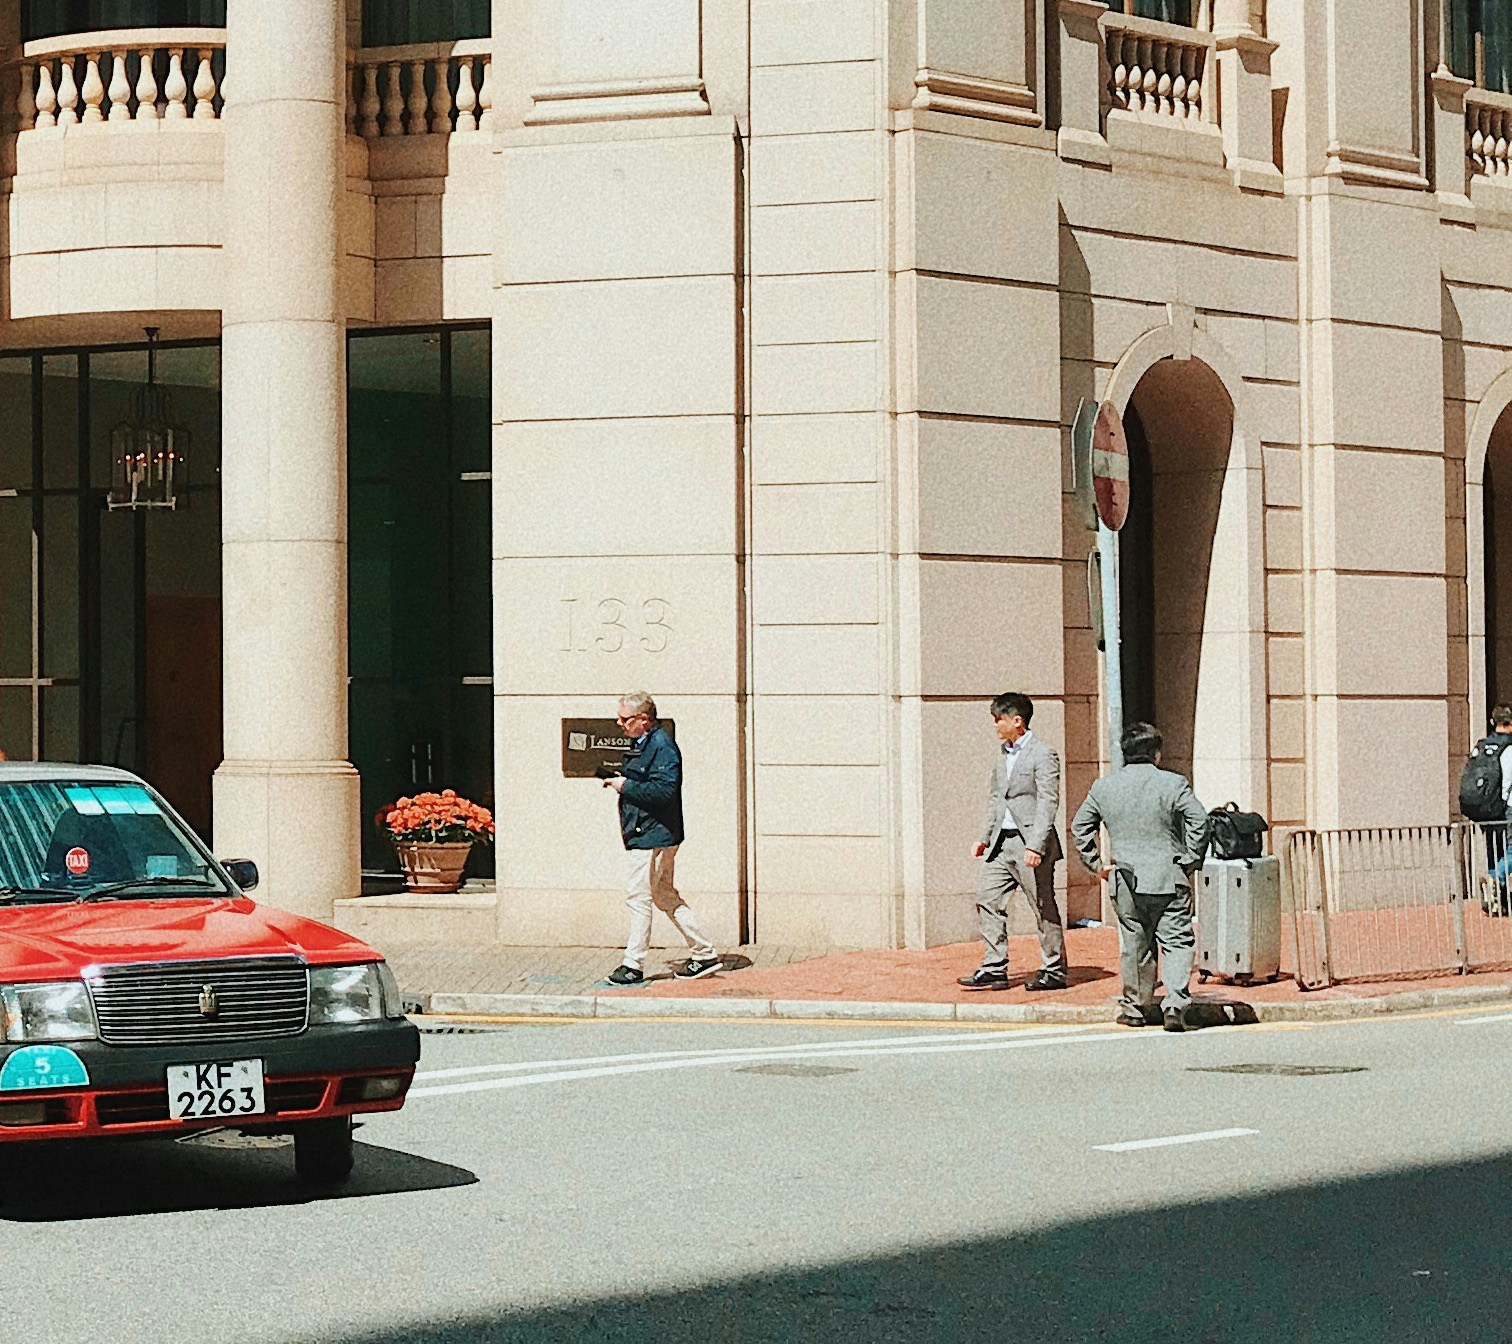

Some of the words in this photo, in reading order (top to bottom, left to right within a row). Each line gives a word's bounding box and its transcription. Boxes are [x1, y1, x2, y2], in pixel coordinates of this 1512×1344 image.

[560, 597, 674, 653] 133
[66, 853, 89, 868] TAXI
[33, 1056, 51, 1075] 5
[194, 1061, 234, 1091] KF
[16, 1073, 71, 1087] SEATS
[177, 1086, 256, 1117] 2263
